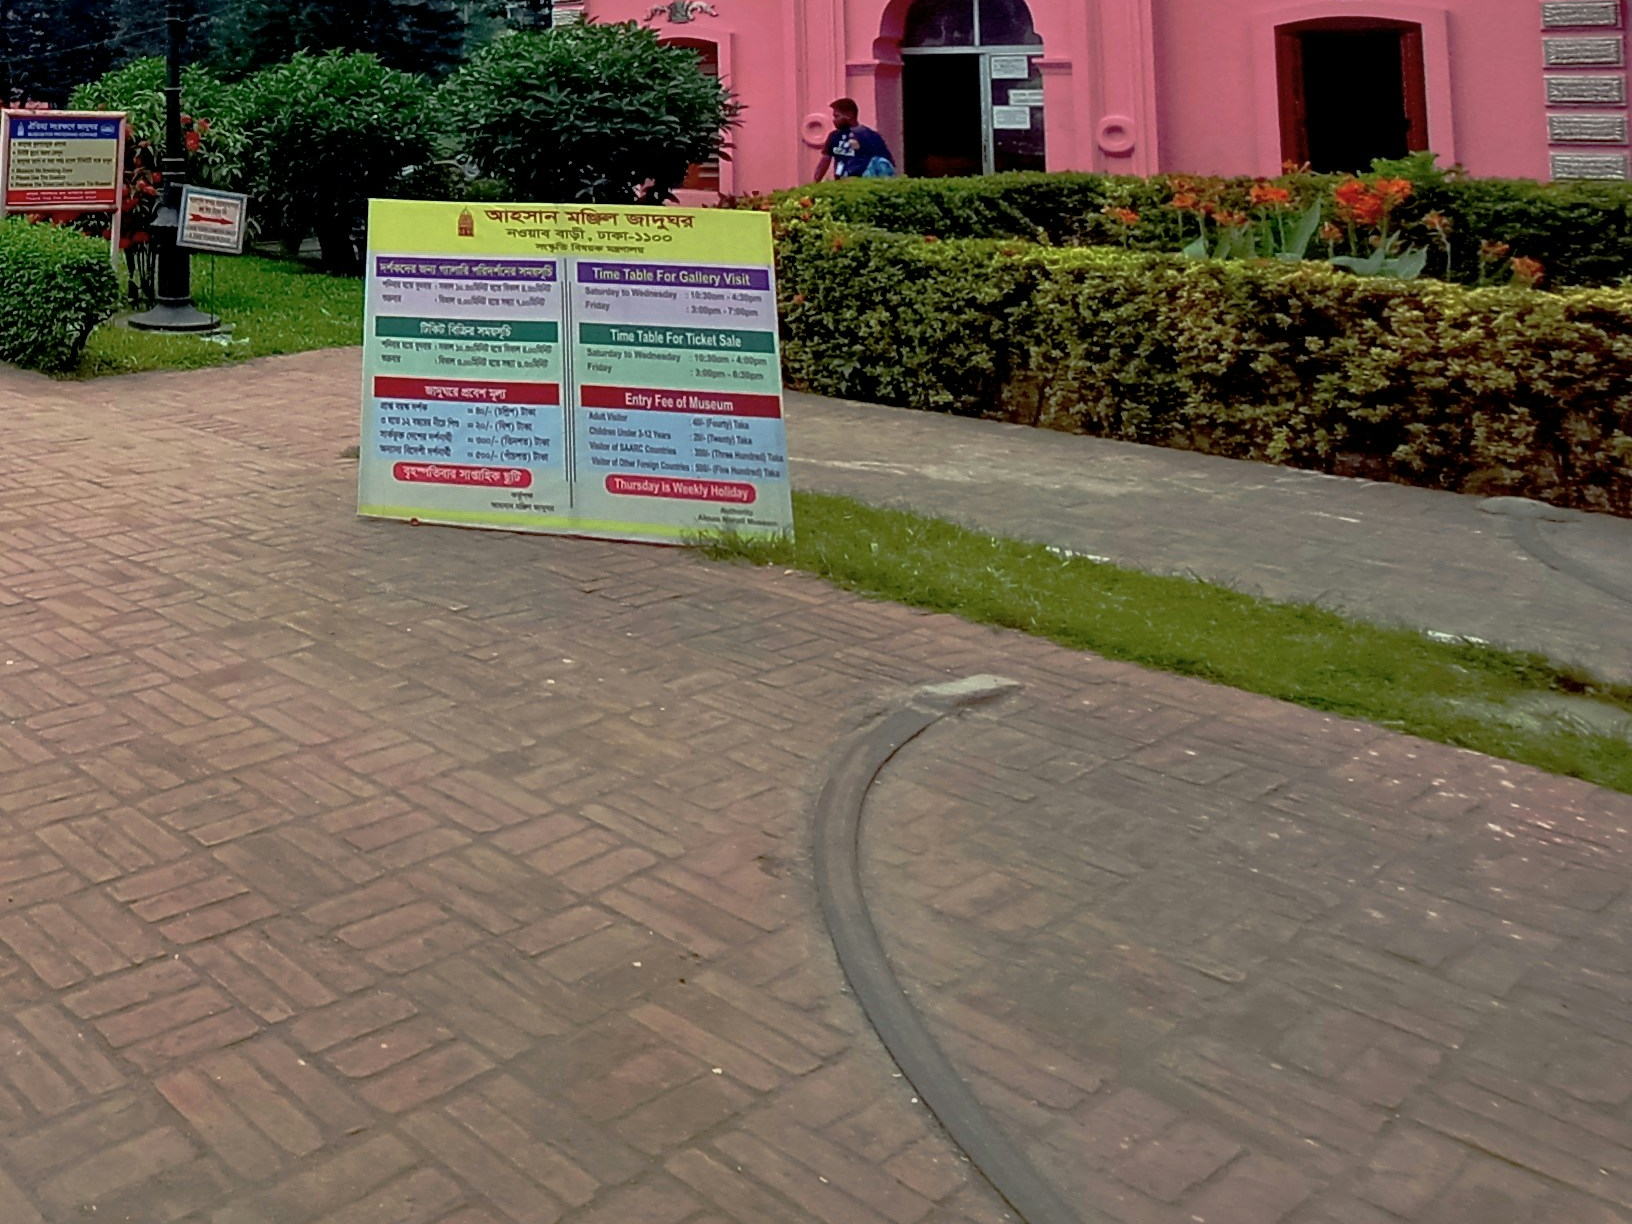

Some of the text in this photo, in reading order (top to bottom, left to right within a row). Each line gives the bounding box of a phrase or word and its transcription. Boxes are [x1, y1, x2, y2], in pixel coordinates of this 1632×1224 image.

[484, 207, 695, 231] আহসান মঞ্জিল জাদুঘর
[506, 228, 550, 238] নওয়াব
[596, 230, 673, 243] ঢাকা-১১০০
[592, 267, 751, 287] Time Table For Gallery Visit
[610, 329, 742, 347] Time Table For Ticket Sale
[625, 392, 733, 411] Entry Fee of Museum
[614, 478, 659, 494] Thursday
[673, 482, 708, 498] Weekly
[710, 484, 748, 501] Holiday
